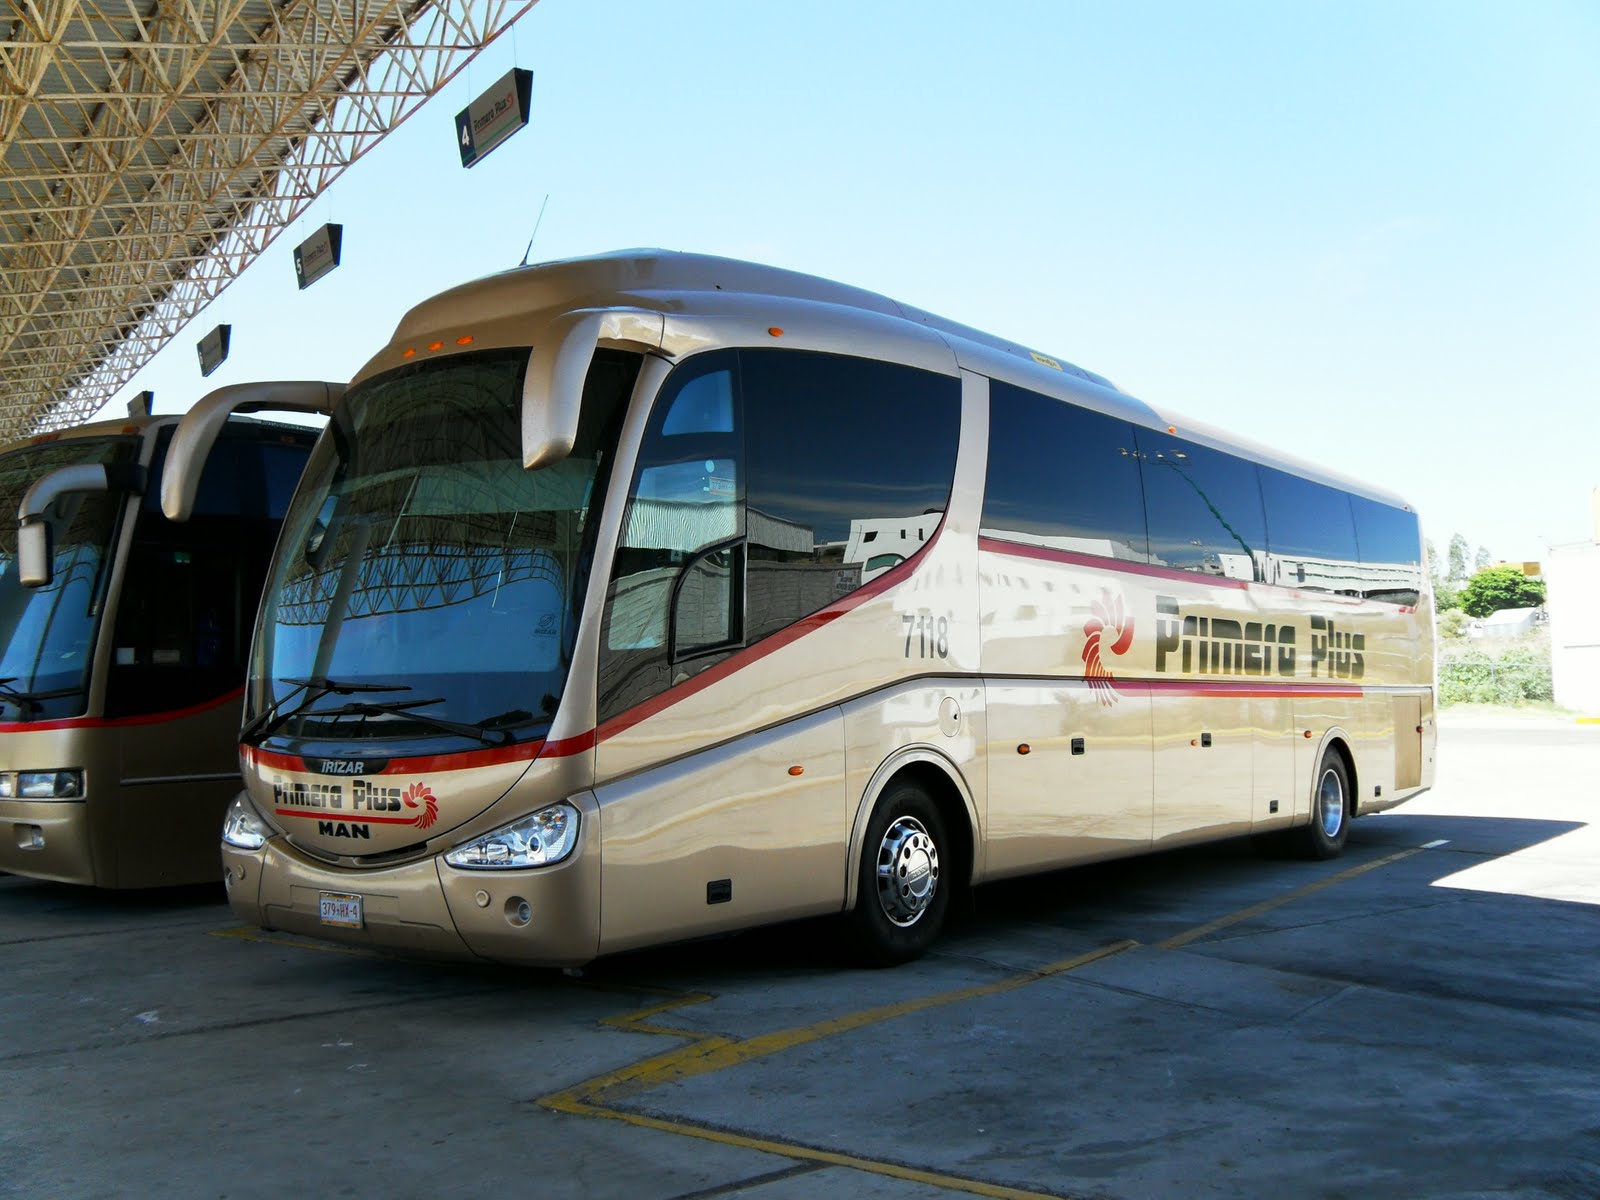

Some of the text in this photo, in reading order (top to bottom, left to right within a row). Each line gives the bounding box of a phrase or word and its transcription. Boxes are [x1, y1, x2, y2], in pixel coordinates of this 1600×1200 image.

[462, 125, 470, 146] 4
[296, 258, 302, 275] 5
[902, 615, 948, 659] 7118
[1155, 595, 1365, 679] Primera Plus
[321, 761, 364, 774] IRIZAR
[273, 776, 401, 811] Primera Plus
[318, 821, 370, 839] MAN
